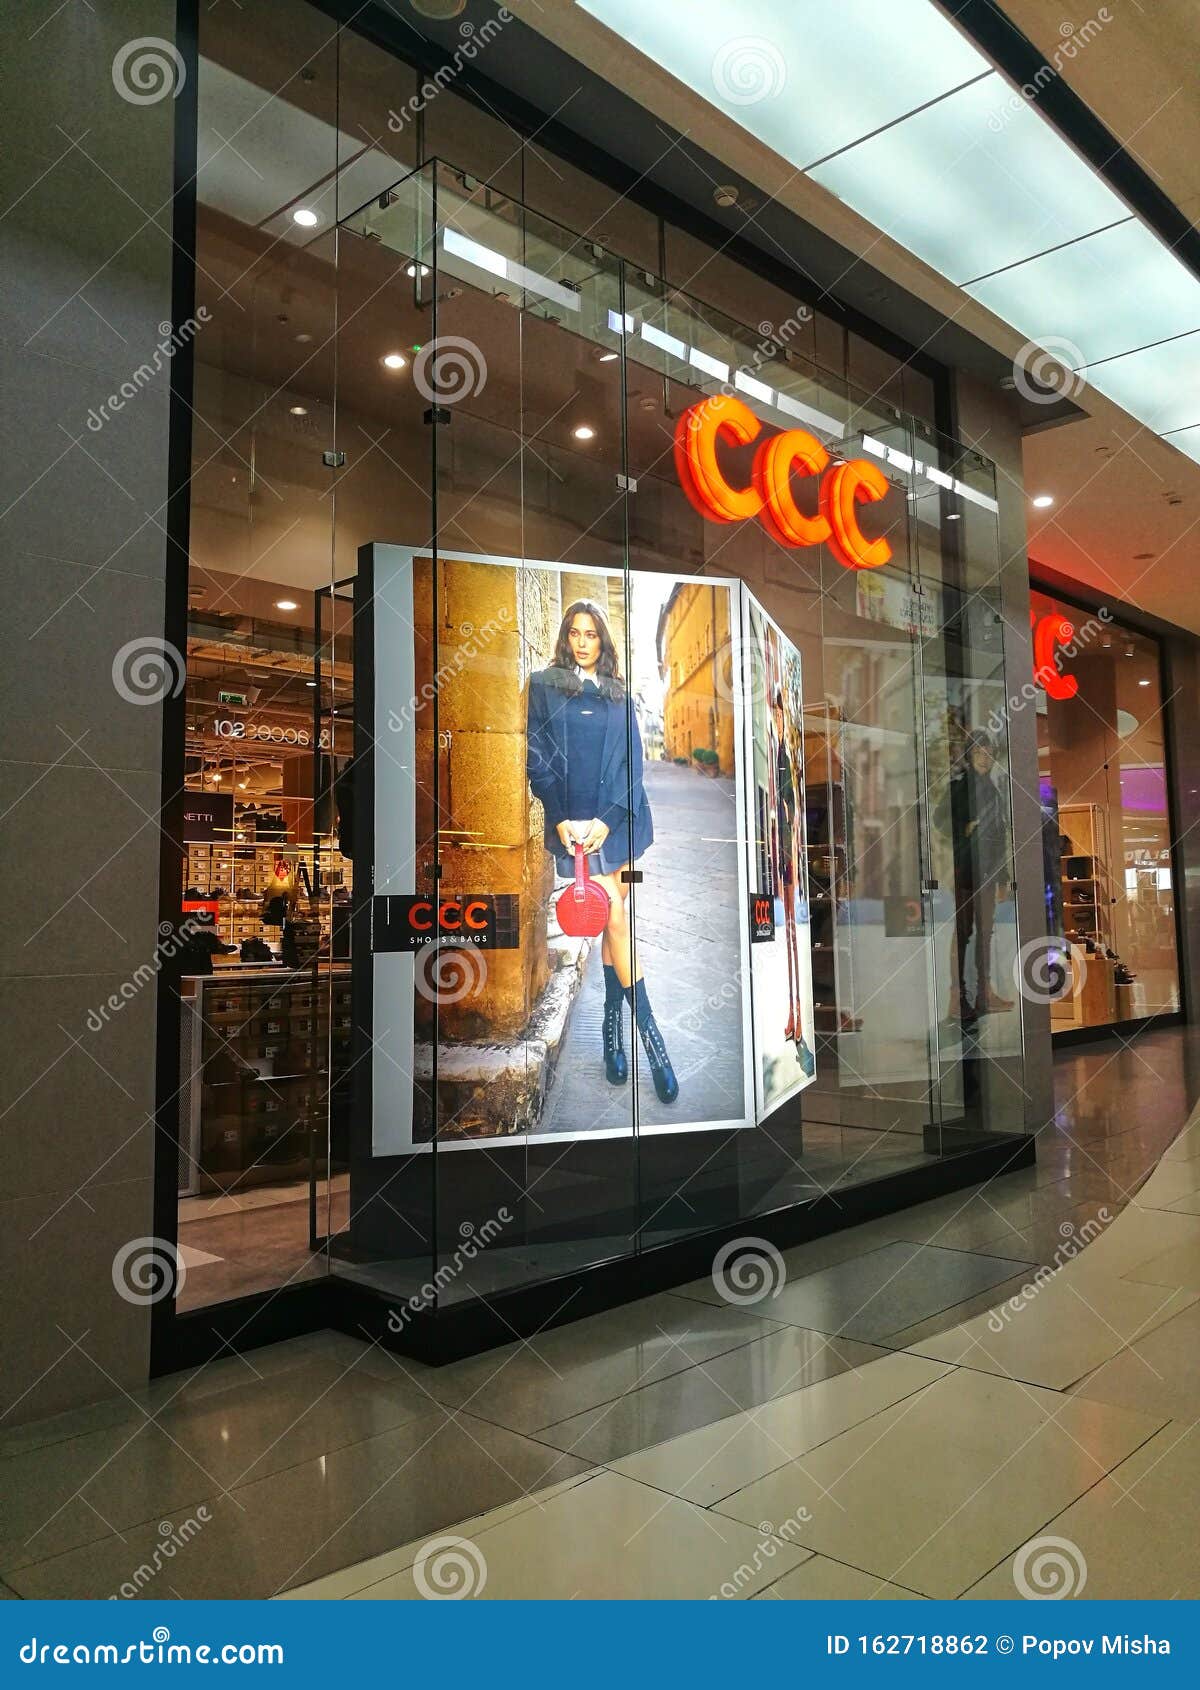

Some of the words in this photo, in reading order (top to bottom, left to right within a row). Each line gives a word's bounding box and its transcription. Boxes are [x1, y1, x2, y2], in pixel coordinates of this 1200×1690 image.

[674, 394, 893, 570] CCC
[408, 902, 488, 931] CCC
[410, 936, 447, 944] SHOS
[460, 935, 488, 943] BAGS
